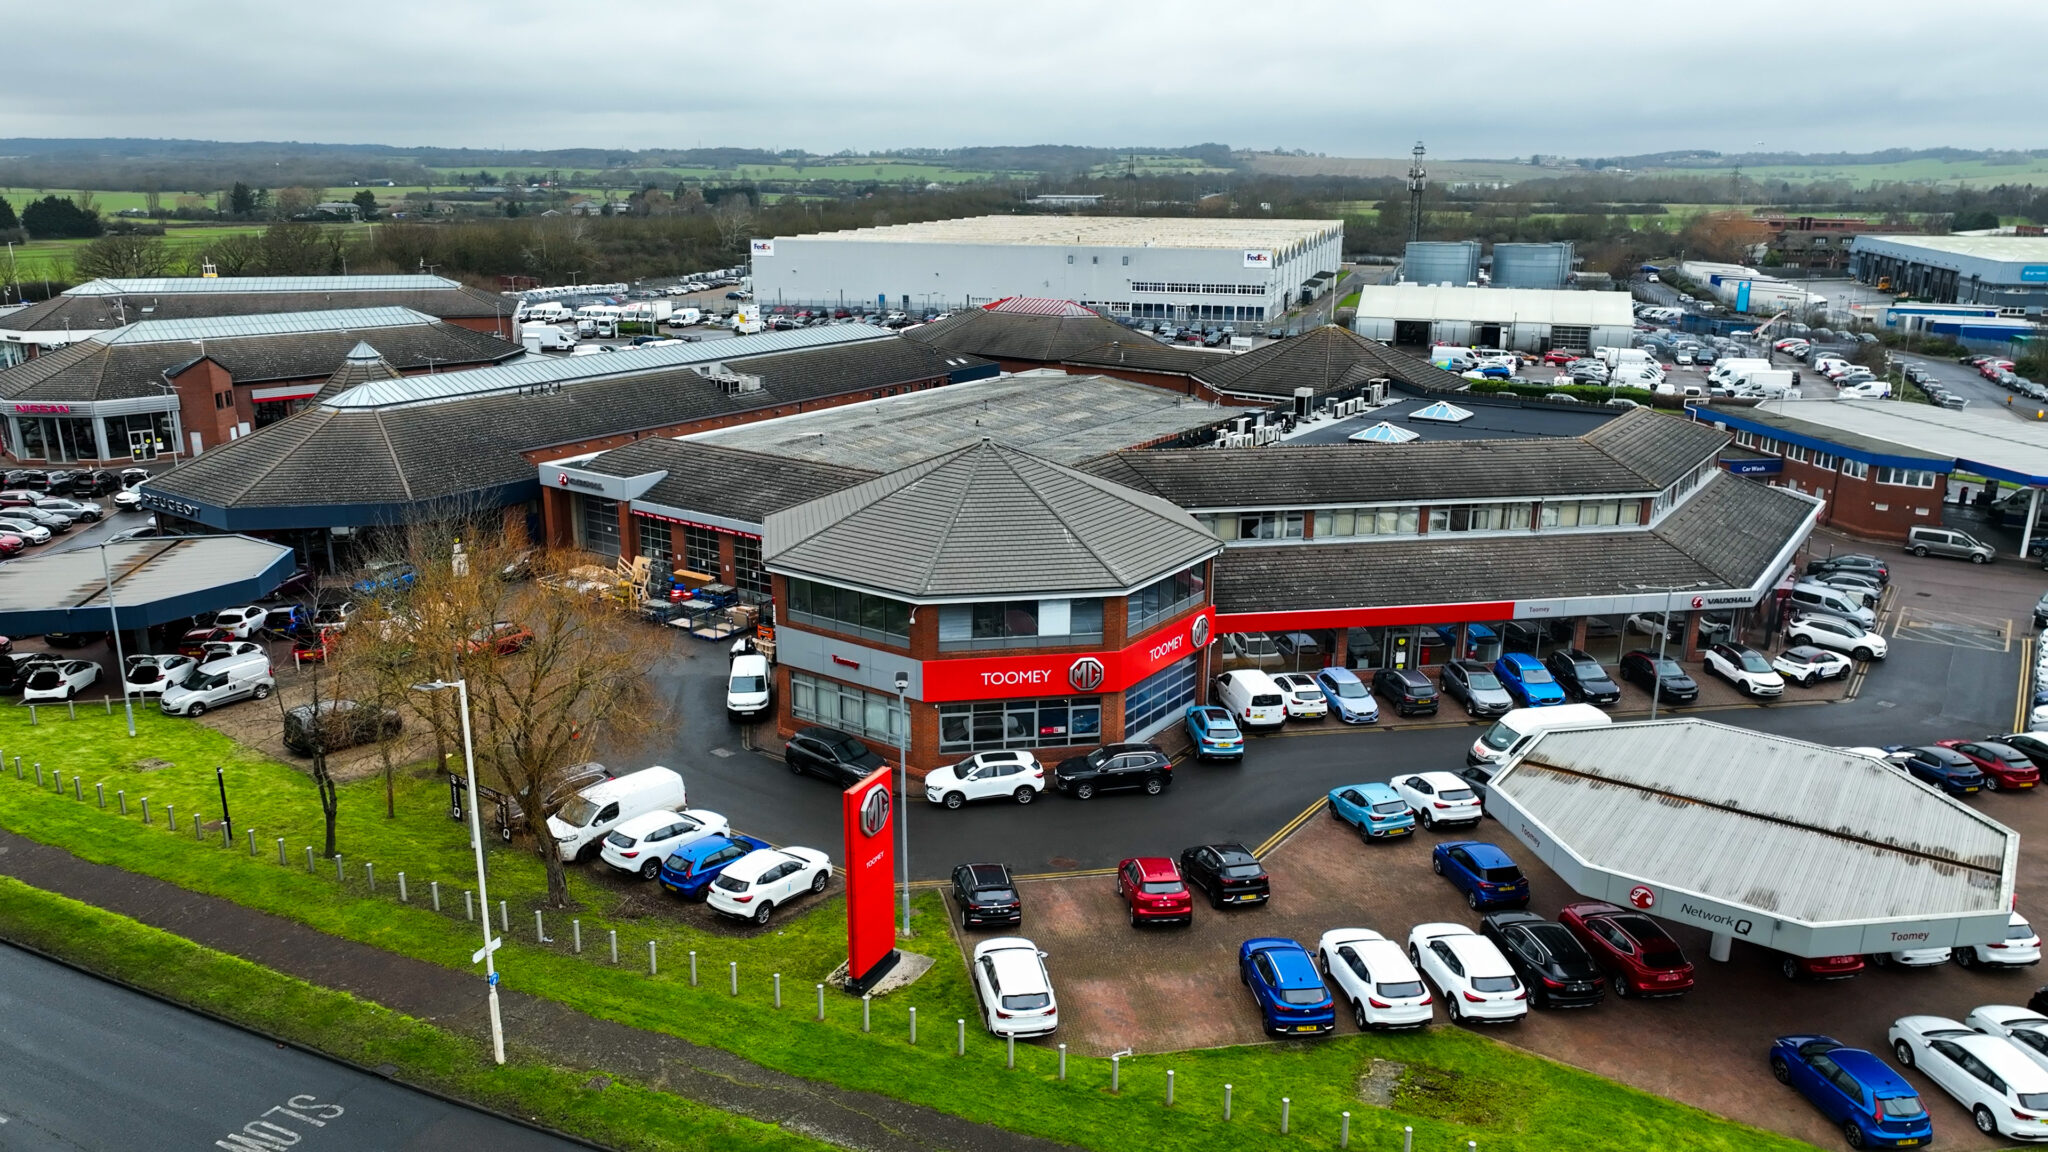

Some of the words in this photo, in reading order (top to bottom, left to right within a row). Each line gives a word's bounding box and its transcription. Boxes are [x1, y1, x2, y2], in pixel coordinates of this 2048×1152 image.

[1247, 253, 1267, 261] FedEx
[15, 404, 71, 414] NISSAN
[143, 492, 201, 519] PEUGEOT
[1708, 596, 1752, 605] VAUXHALL
[1193, 616, 1209, 647] MG
[1149, 633, 1184, 662] TOOMEY
[981, 669, 1052, 686] TOOMEY
[1071, 659, 1102, 689] MG
[863, 785, 890, 835] MG
[1521, 823, 1541, 848] Toomey
[866, 851, 885, 869] TOOMEY
[1681, 903, 1734, 927] Network
[1734, 919, 1752, 936] Q
[1891, 931, 1930, 942] Toomey
